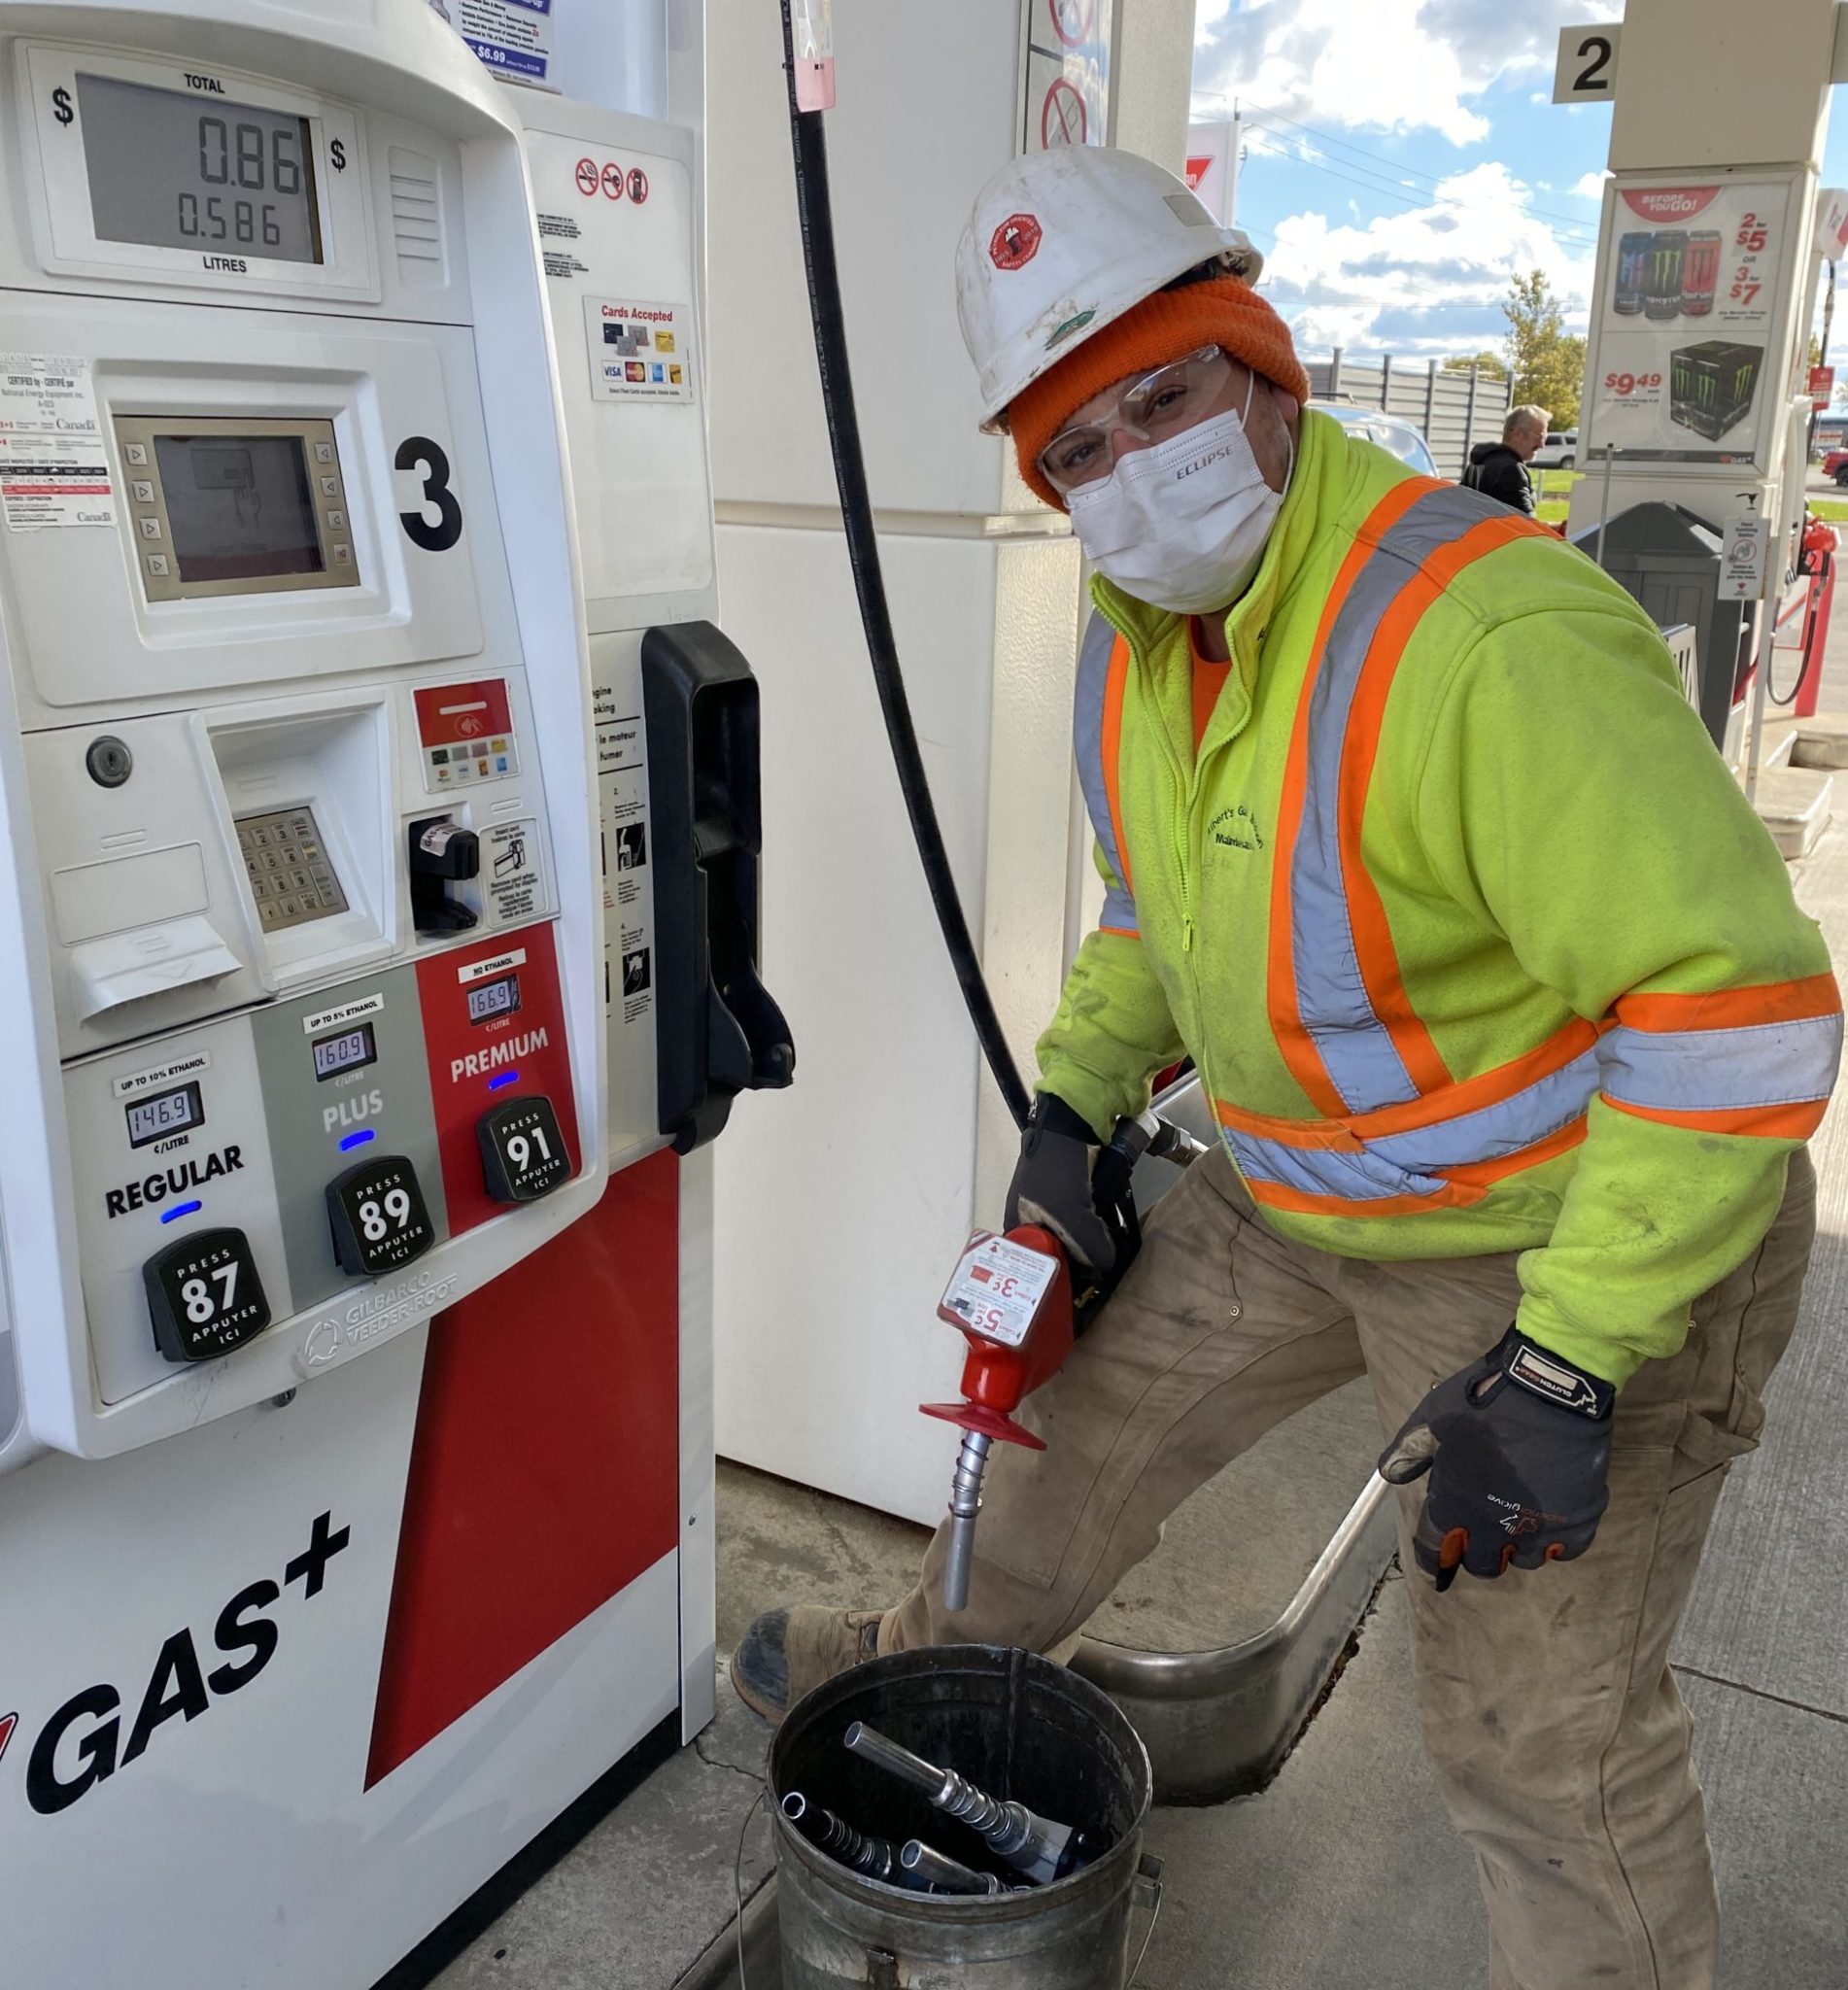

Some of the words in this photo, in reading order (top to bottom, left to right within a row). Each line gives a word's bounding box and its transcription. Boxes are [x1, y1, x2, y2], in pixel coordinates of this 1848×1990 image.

[477, 45, 505, 63] $6.99
[1572, 36, 1613, 91] 2
[185, 73, 225, 94] TOTAL
[51, 86, 75, 127] $
[198, 116, 300, 194] 0.86
[329, 137, 347, 174] $
[178, 192, 281, 246] 0.586
[1670, 199, 1698, 212] GO!
[1740, 213, 1757, 229] 2
[1736, 229, 1768, 253] $5
[202, 256, 247, 273] LITRES
[1742, 255, 1757, 264] OR
[1734, 266, 1749, 282] 3
[1729, 284, 1762, 307] $7
[601, 305, 629, 319] Cards
[631, 307, 673, 323] Accepted
[604, 367, 622, 377] VISA
[55, 418, 95, 430] Canada
[1177, 443, 1234, 481] ECLIPSE
[394, 436, 462, 551] 3
[77, 511, 111, 522] Canada
[599, 735, 607, 744] le
[608, 731, 637, 743] moteur
[599, 749, 624, 762] fumer
[473, 966, 484, 977] NO
[484, 957, 514, 973] ETHANOL
[471, 985, 506, 1014] 166.9
[310, 1017, 322, 1028] UP
[322, 1012, 332, 1024] TO
[333, 1010, 345, 1020] 5%
[346, 1000, 378, 1016] ETHANOL
[317, 1035, 361, 1068] 160.9
[451, 1026, 549, 1083] PREMIUM
[120, 1081, 134, 1090] UP
[135, 1076, 148, 1087] TO
[149, 1067, 167, 1082] 10%
[168, 1056, 206, 1077] ETHANOL
[133, 1095, 186, 1132] 146.9
[323, 1088, 384, 1133] PLUS
[501, 1113, 540, 1135] PRESS
[506, 1127, 552, 1172] 91
[105, 1145, 245, 1219] REGULAR
[357, 1174, 400, 1200] PRESS
[515, 1159, 562, 1187] APPUYER
[533, 1177, 550, 1190] ICI
[359, 1188, 410, 1241] 89
[369, 1226, 424, 1258] APPUYER
[392, 1247, 409, 1261] ICI
[177, 1249, 230, 1279] PRESS
[182, 1261, 238, 1323] 87
[345, 1271, 431, 1324] GILBARCO
[192, 1305, 257, 1343] APPUYER
[346, 1279, 459, 1346] VEEDER-ROOT
[219, 1327, 240, 1345] ICI
[1487, 1493, 1522, 1512] glove
